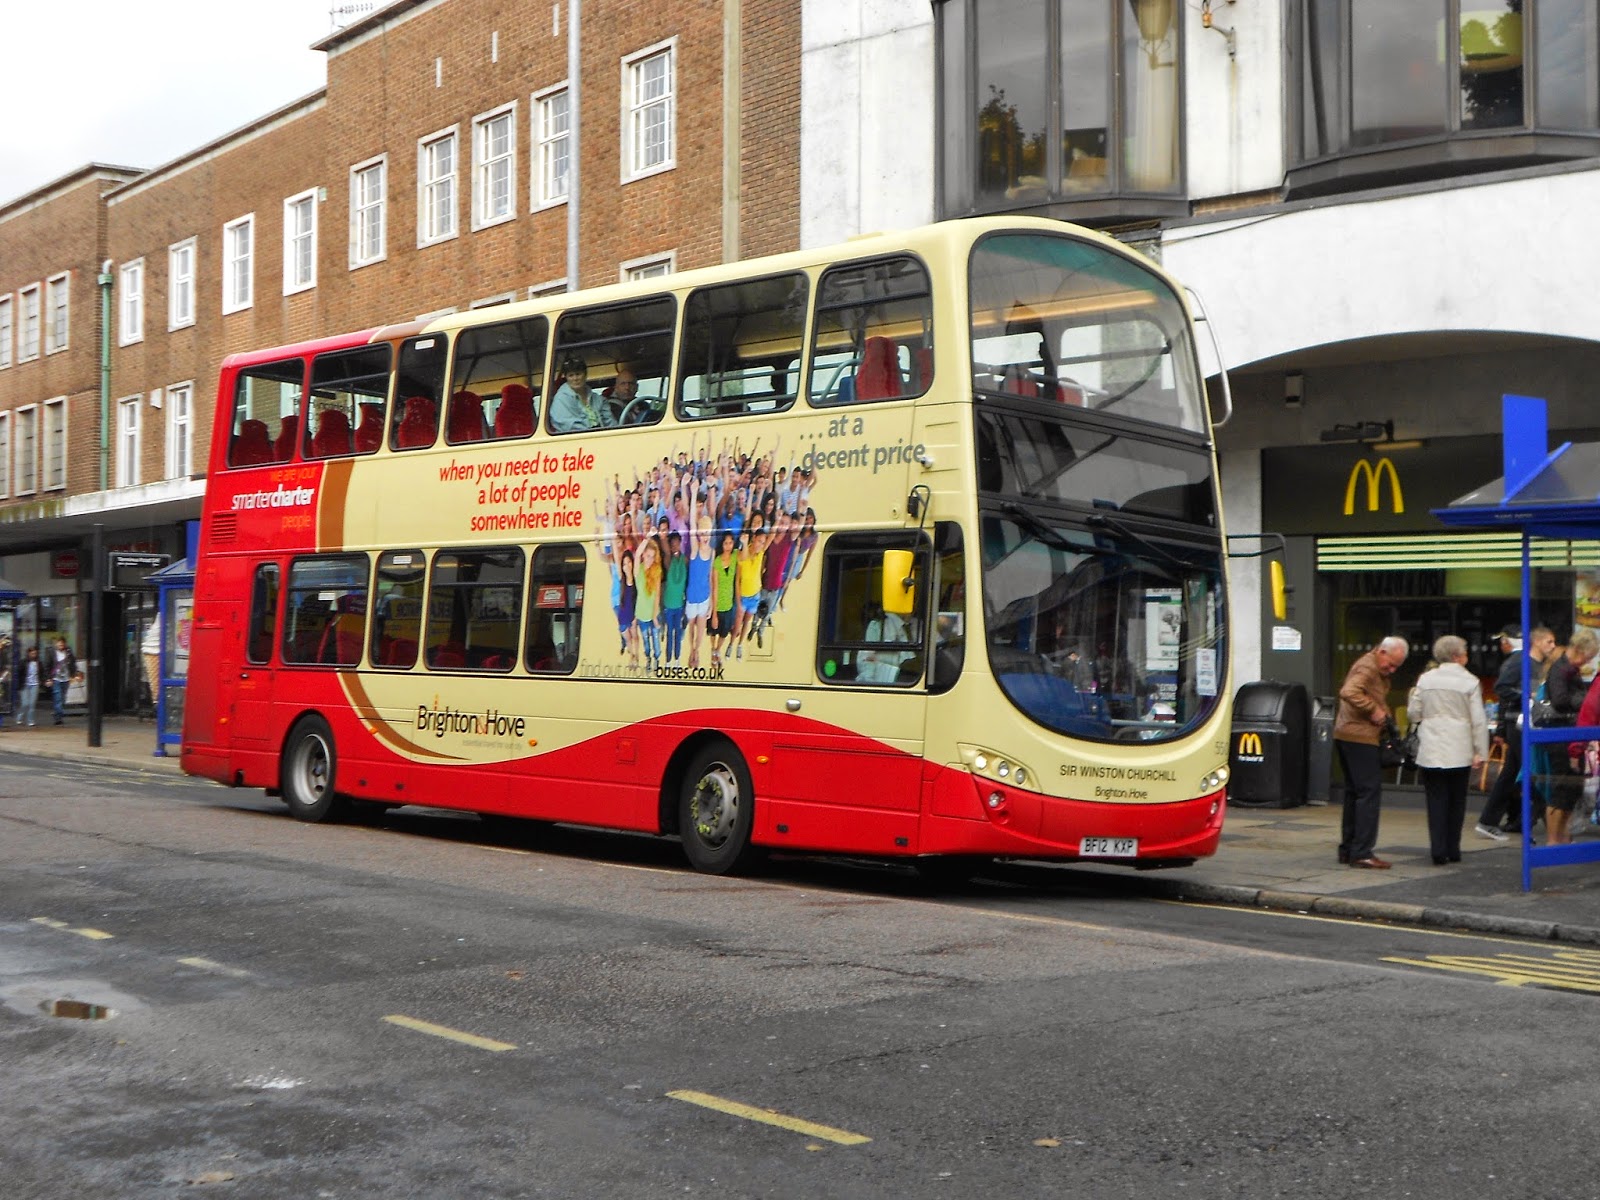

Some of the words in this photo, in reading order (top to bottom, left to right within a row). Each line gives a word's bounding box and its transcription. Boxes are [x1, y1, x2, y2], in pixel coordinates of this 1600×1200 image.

[852, 417, 864, 436] a
[439, 459, 474, 482] when
[476, 461, 502, 485] you
[504, 451, 541, 477] need
[543, 454, 559, 473] to
[562, 447, 595, 472] take
[802, 443, 870, 469] decent
[873, 438, 926, 474] price
[478, 488, 486, 505] a
[489, 481, 508, 504] lot
[511, 479, 528, 502] of
[529, 475, 580, 508] people
[470, 506, 550, 531] somewhere
[552, 505, 582, 527] nice
[1060, 764, 1077, 776] SIR
[1080, 766, 1125, 779] WINSTON
[1127, 769, 1177, 781] CHURCHILL
[1095, 786, 1128, 800] Brighton
[1128, 789, 1148, 799] Hove
[1084, 838, 1108, 853] BF12
[1113, 840, 1134, 854] KXP
